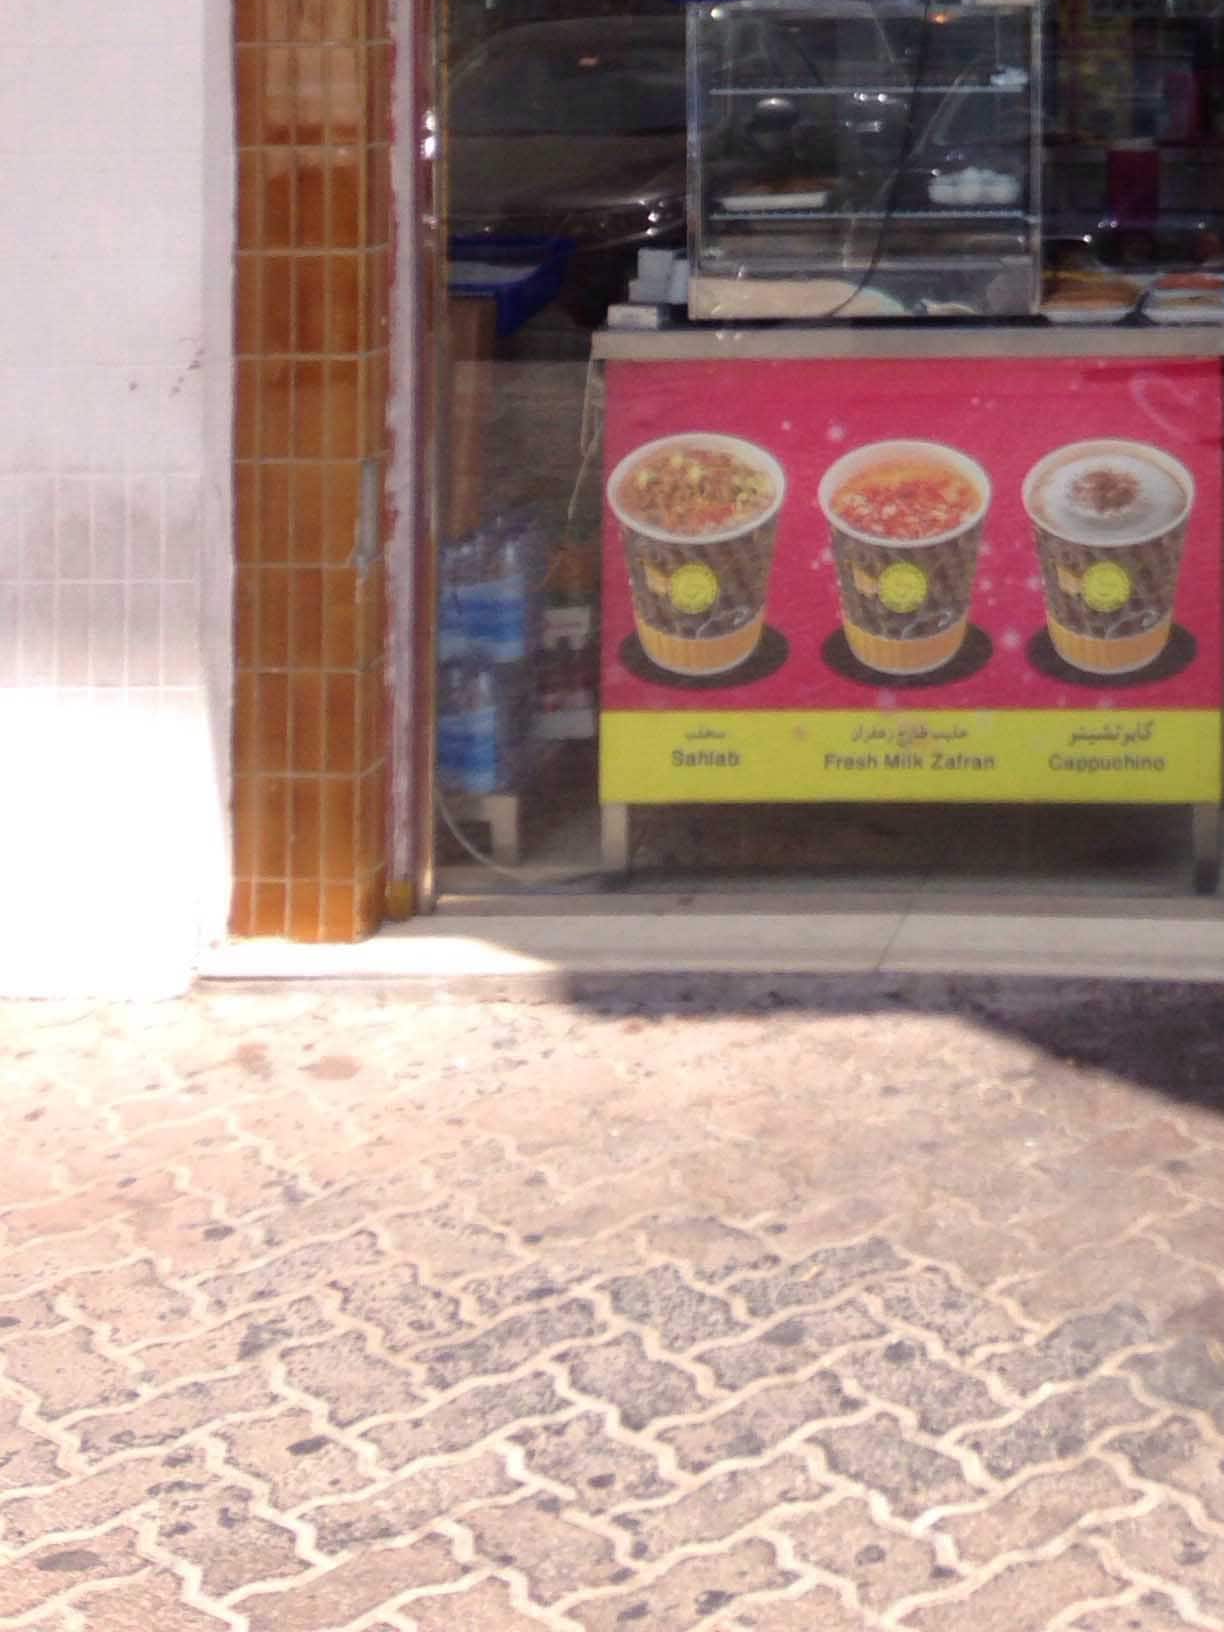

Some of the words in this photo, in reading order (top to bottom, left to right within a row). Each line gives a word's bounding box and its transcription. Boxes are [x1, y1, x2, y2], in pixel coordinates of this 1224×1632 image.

[670, 748, 741, 768] Sahlab
[823, 752, 879, 771] Fresh
[884, 752, 924, 770] Milk
[930, 752, 996, 771] Zafran
